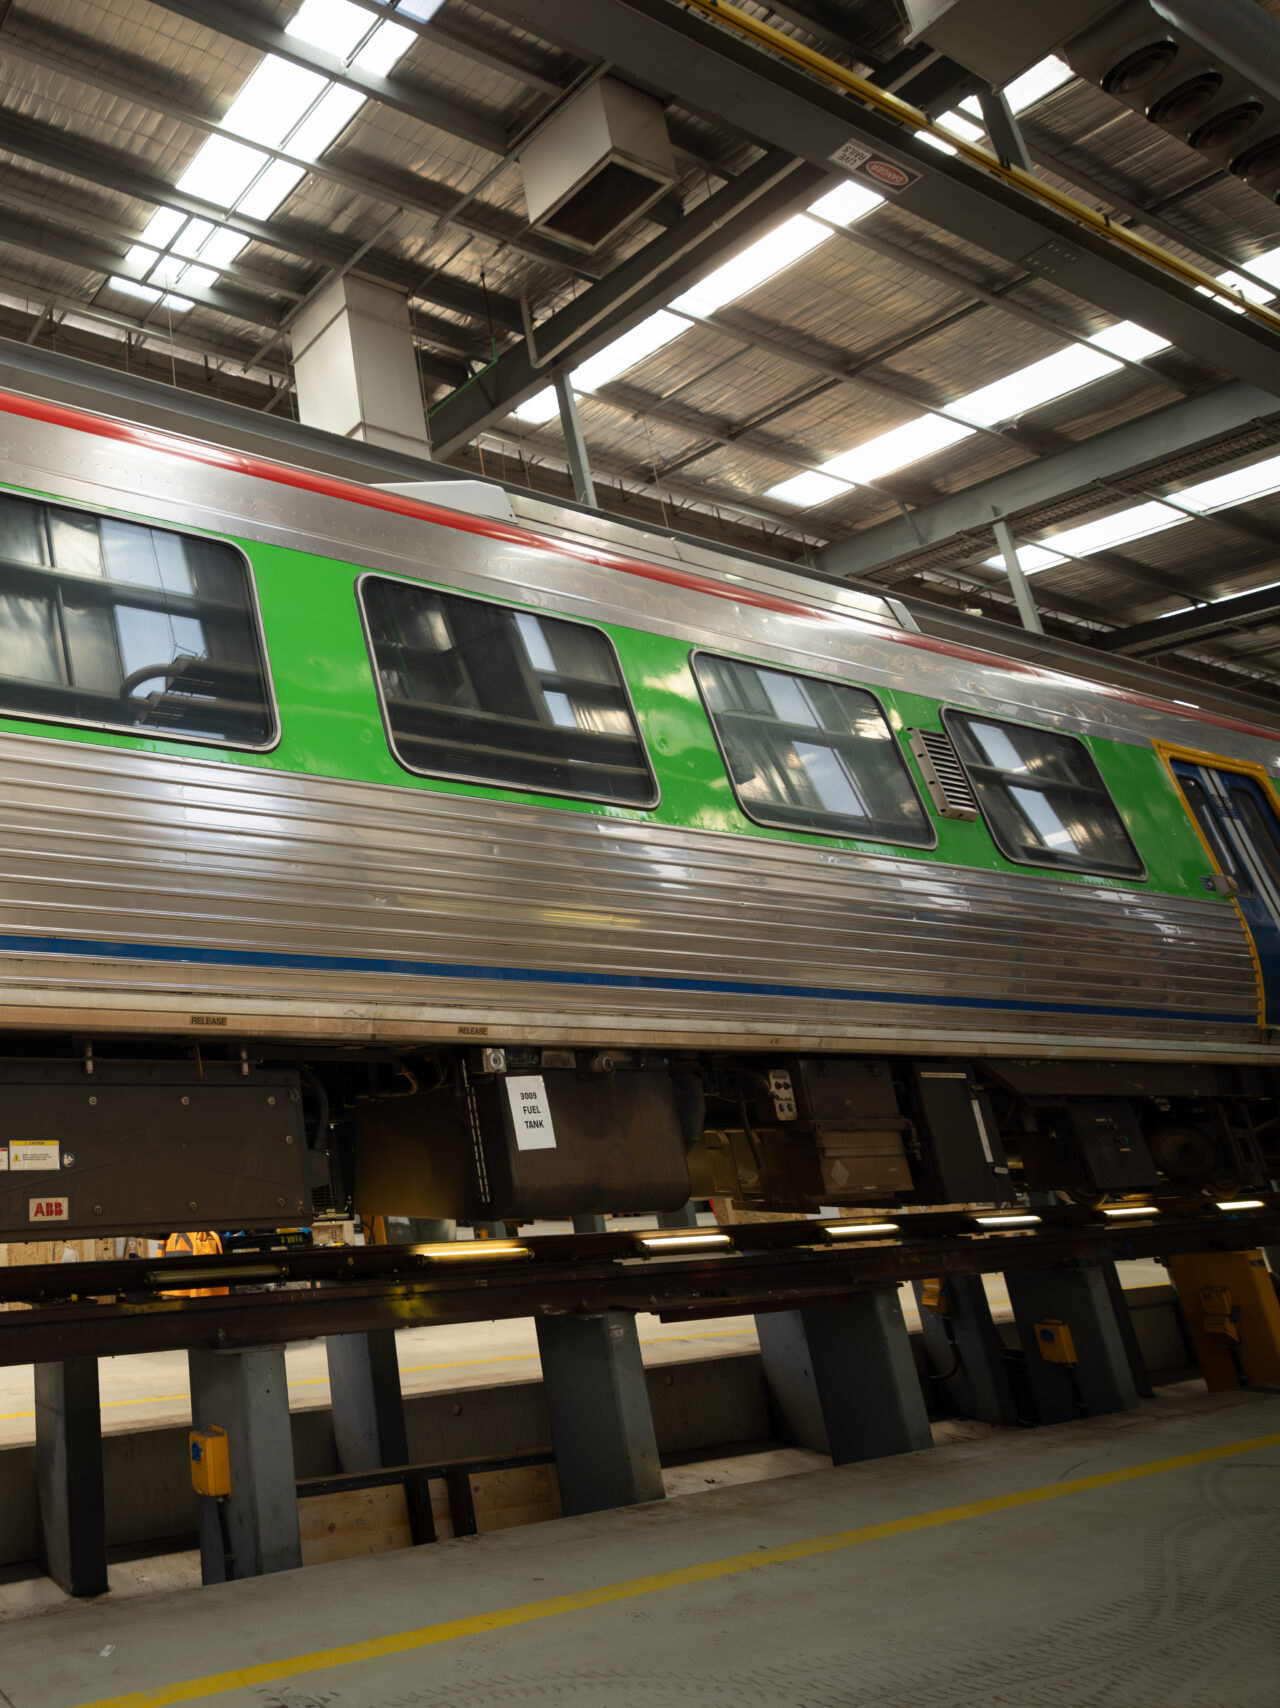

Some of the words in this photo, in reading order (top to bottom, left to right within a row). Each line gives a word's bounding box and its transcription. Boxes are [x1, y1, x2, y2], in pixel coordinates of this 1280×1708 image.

[842, 145, 869, 160] RAILS
[839, 153, 857, 166] LIVE
[870, 164, 904, 183] DANGER
[191, 1016, 227, 1025] RELEASE
[458, 1026, 487, 1035] RELEASE
[520, 1092, 537, 1100] 3009
[522, 1105, 541, 1114] FUEL
[524, 1120, 545, 1129] TANK
[33, 1202, 64, 1217] ABB
